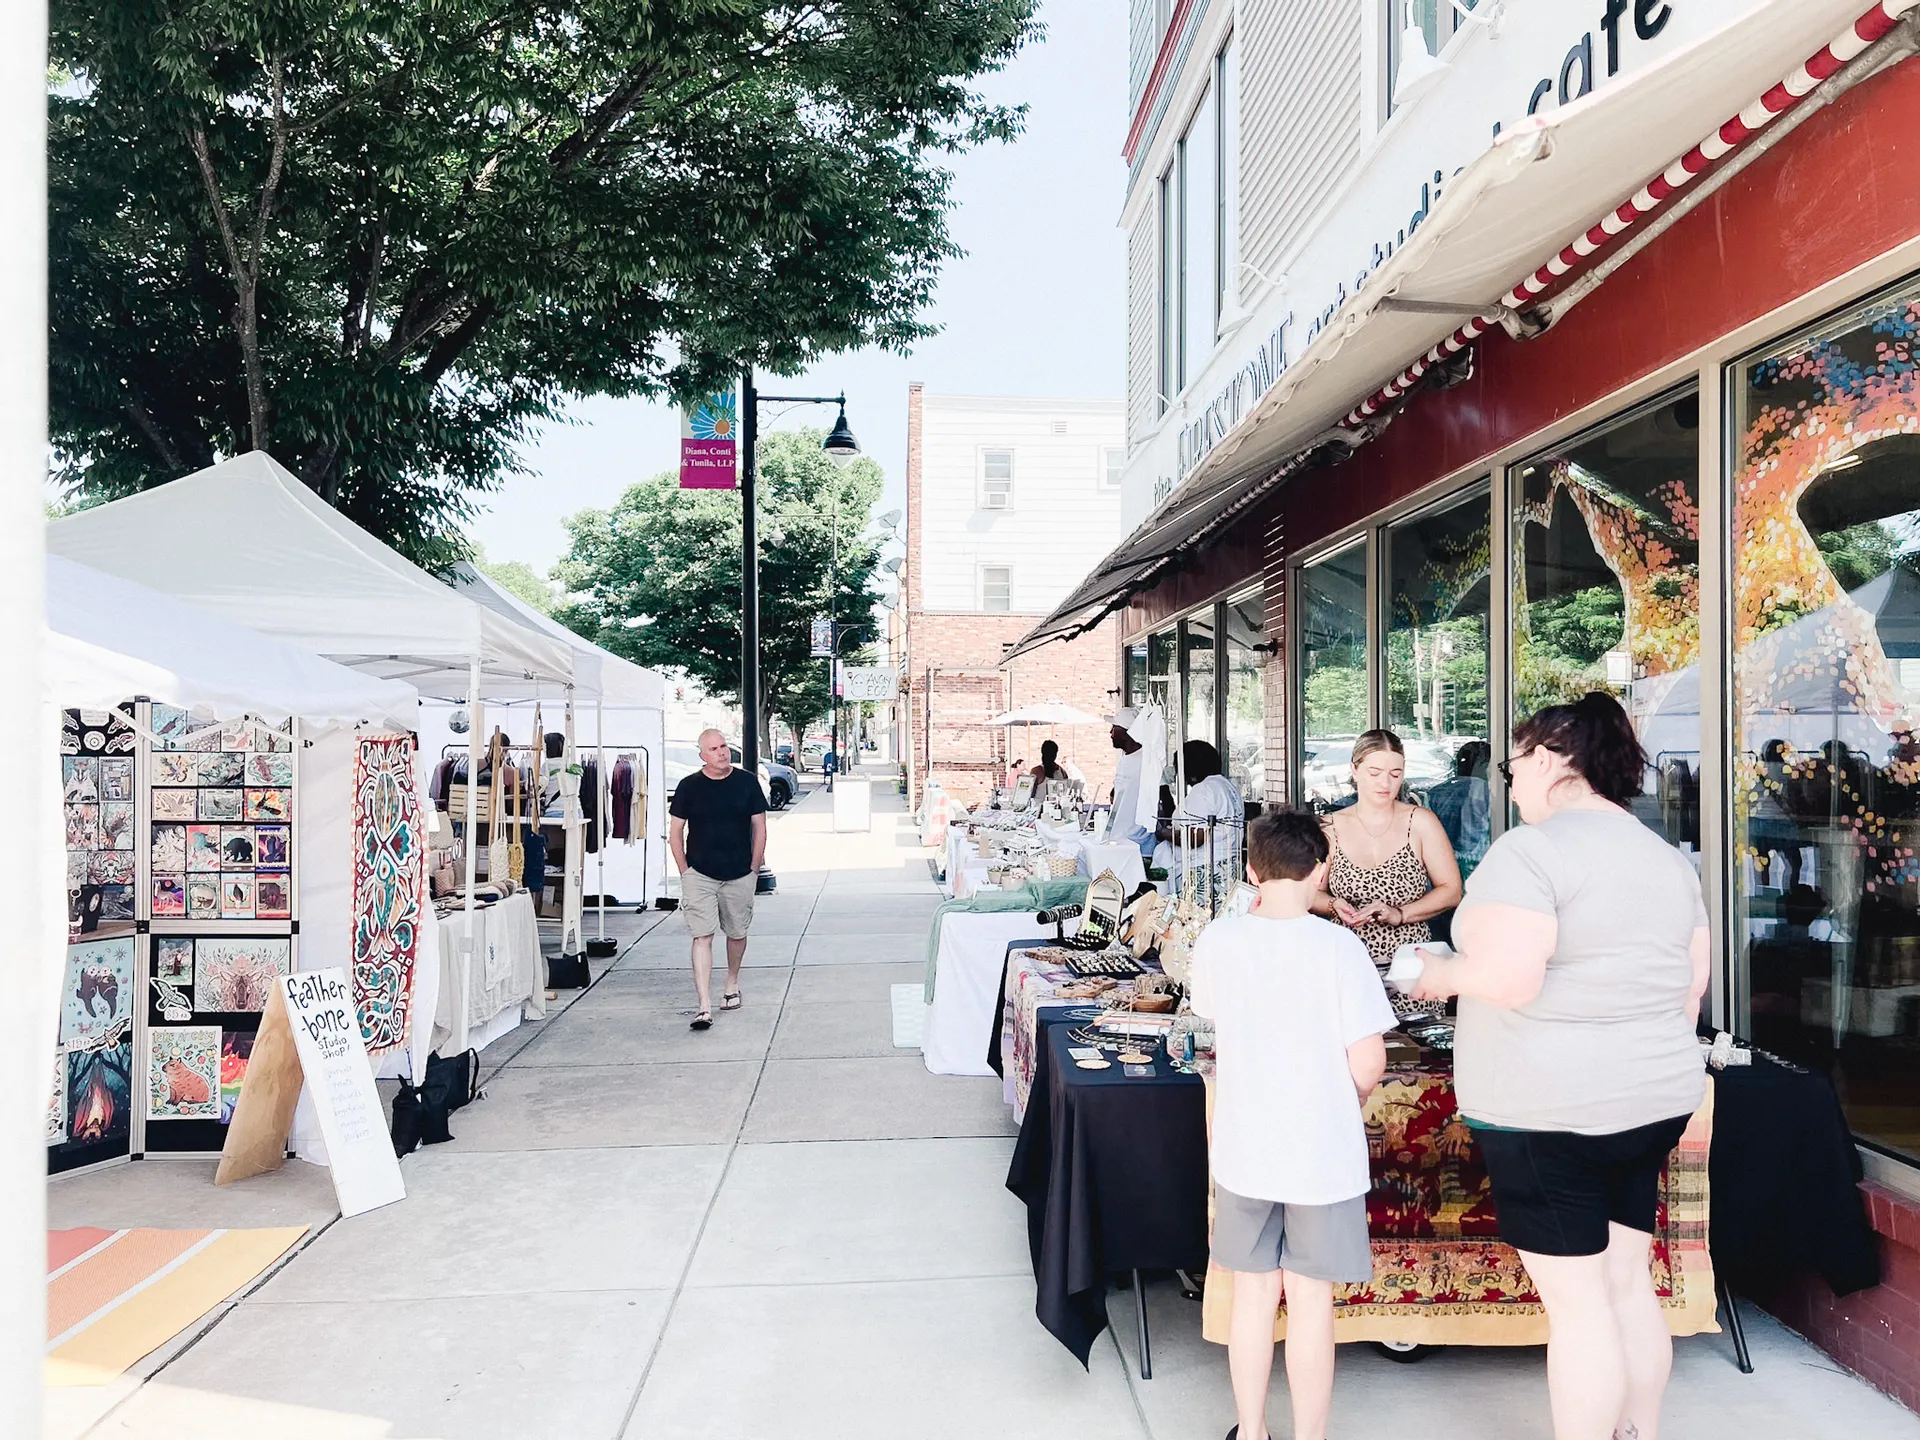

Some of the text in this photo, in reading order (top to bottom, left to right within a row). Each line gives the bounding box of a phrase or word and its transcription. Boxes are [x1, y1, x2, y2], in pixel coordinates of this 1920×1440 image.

[685, 446, 731, 456] Diana, Conti
[681, 458, 689, 467] &
[717, 459, 735, 468] LLP
[867, 685, 888, 697] EGG
[287, 974, 347, 1010] feather
[317, 1035, 347, 1050] studio
